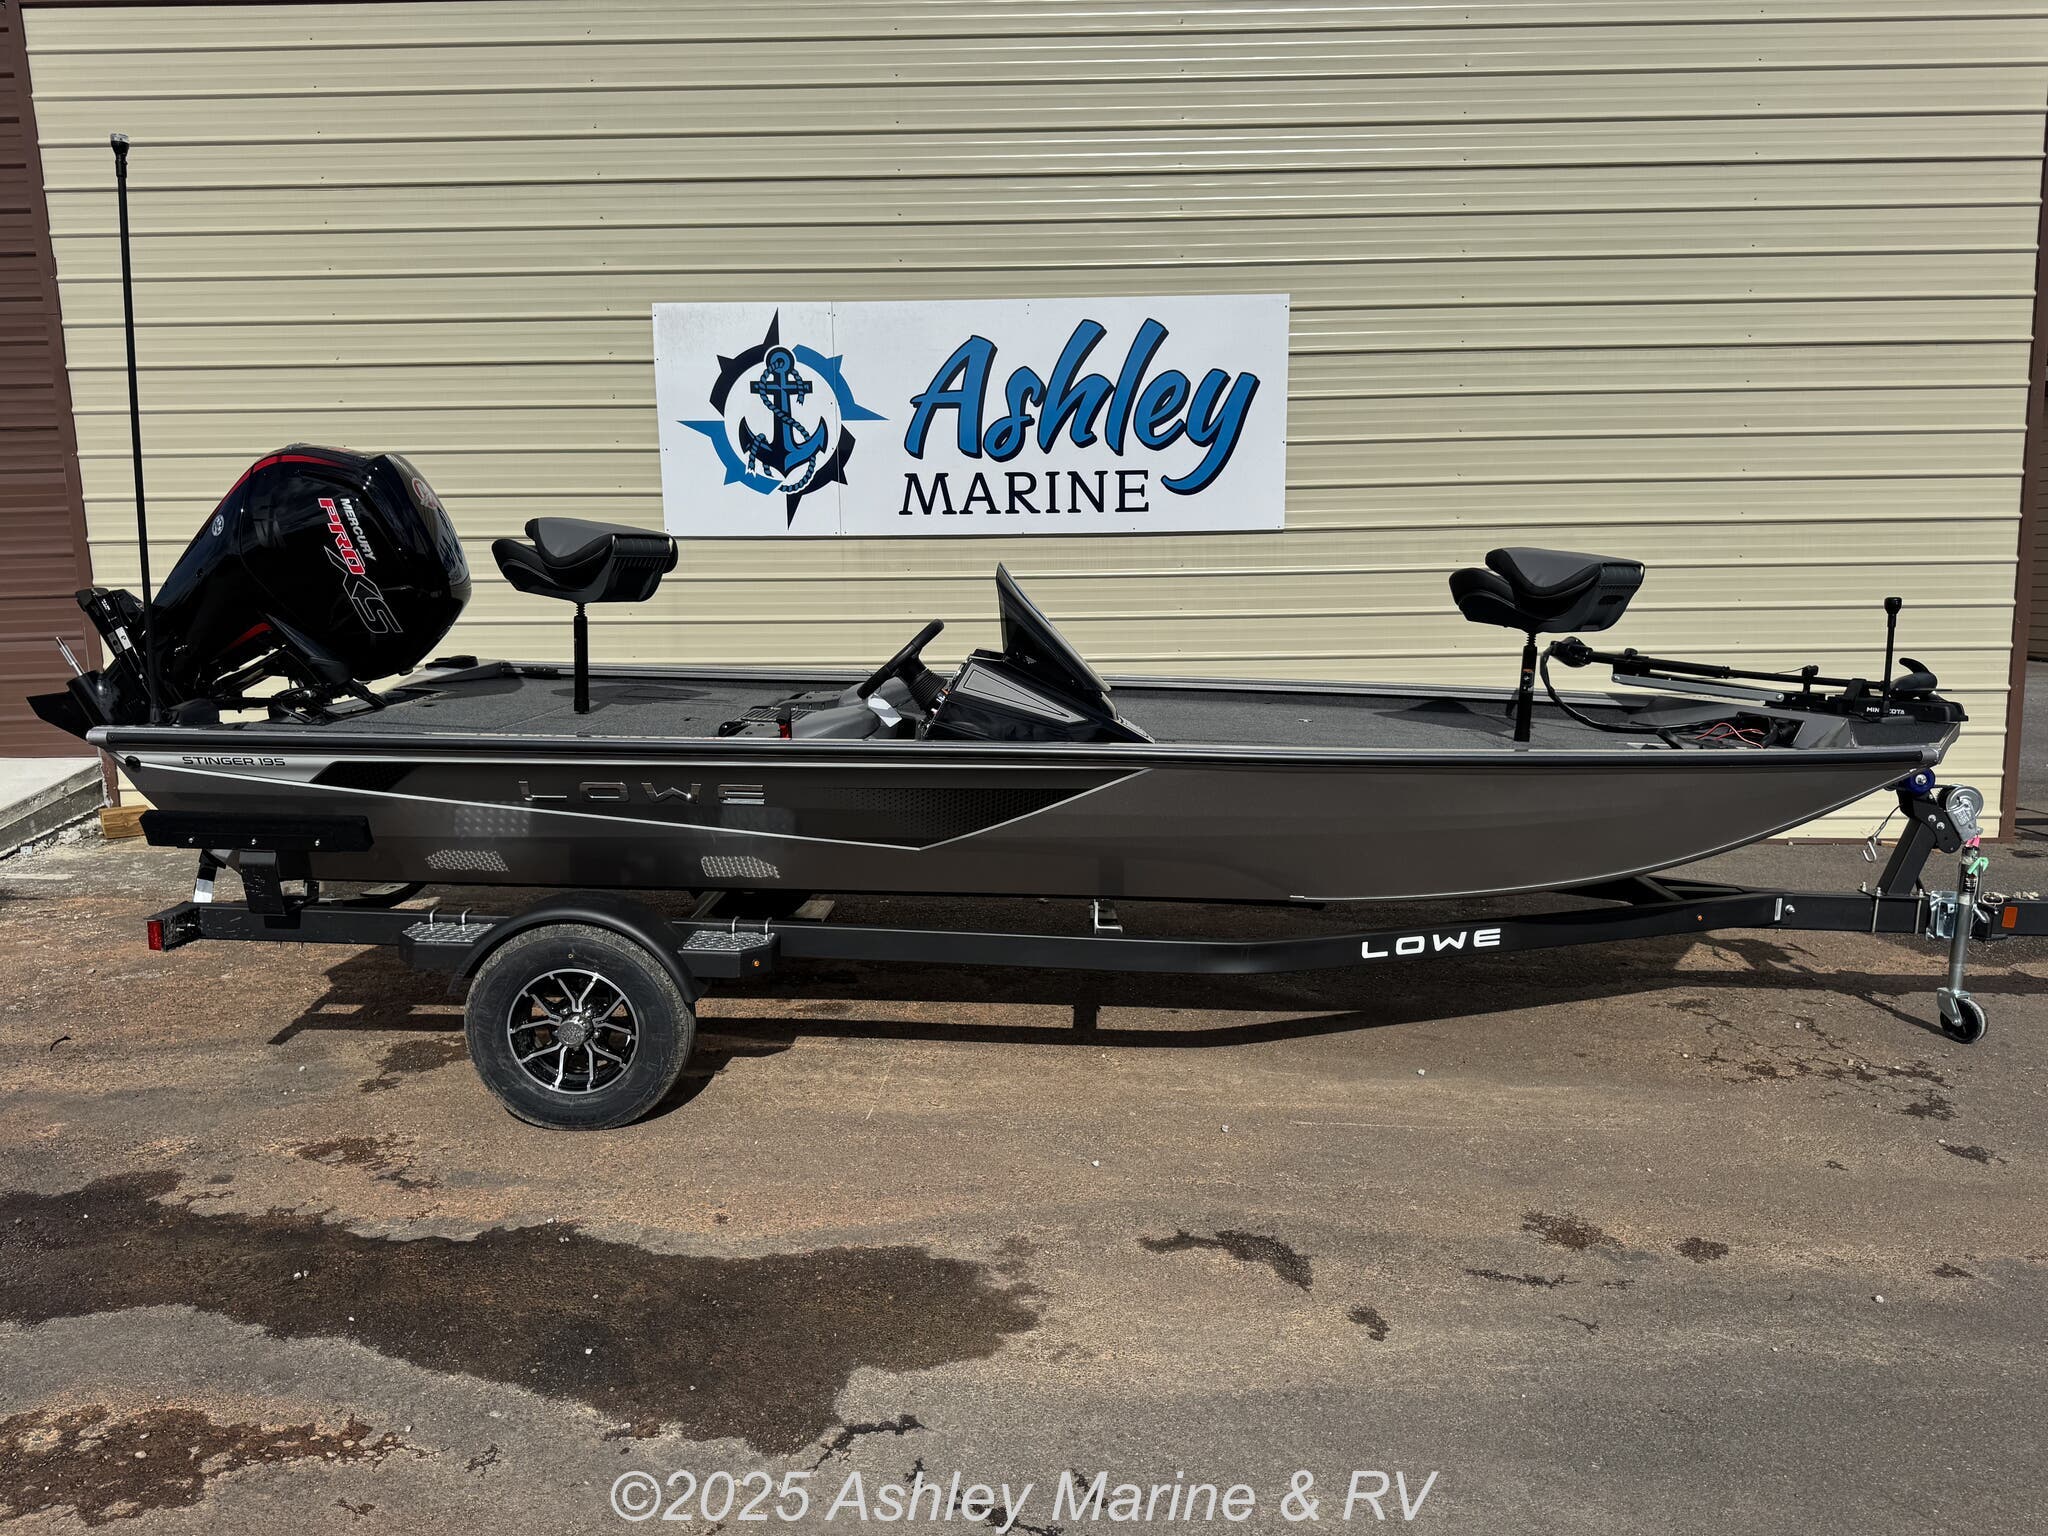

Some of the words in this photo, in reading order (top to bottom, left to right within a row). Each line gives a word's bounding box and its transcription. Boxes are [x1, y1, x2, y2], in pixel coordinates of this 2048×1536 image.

[904, 318, 1260, 495] Ashley
[898, 469, 1150, 515] MARINE
[340, 498, 377, 561] MERCURY
[182, 756, 255, 766] STINGER
[257, 757, 286, 766] 195
[518, 780, 765, 805] LOWE
[1361, 927, 1501, 959] LOWE
